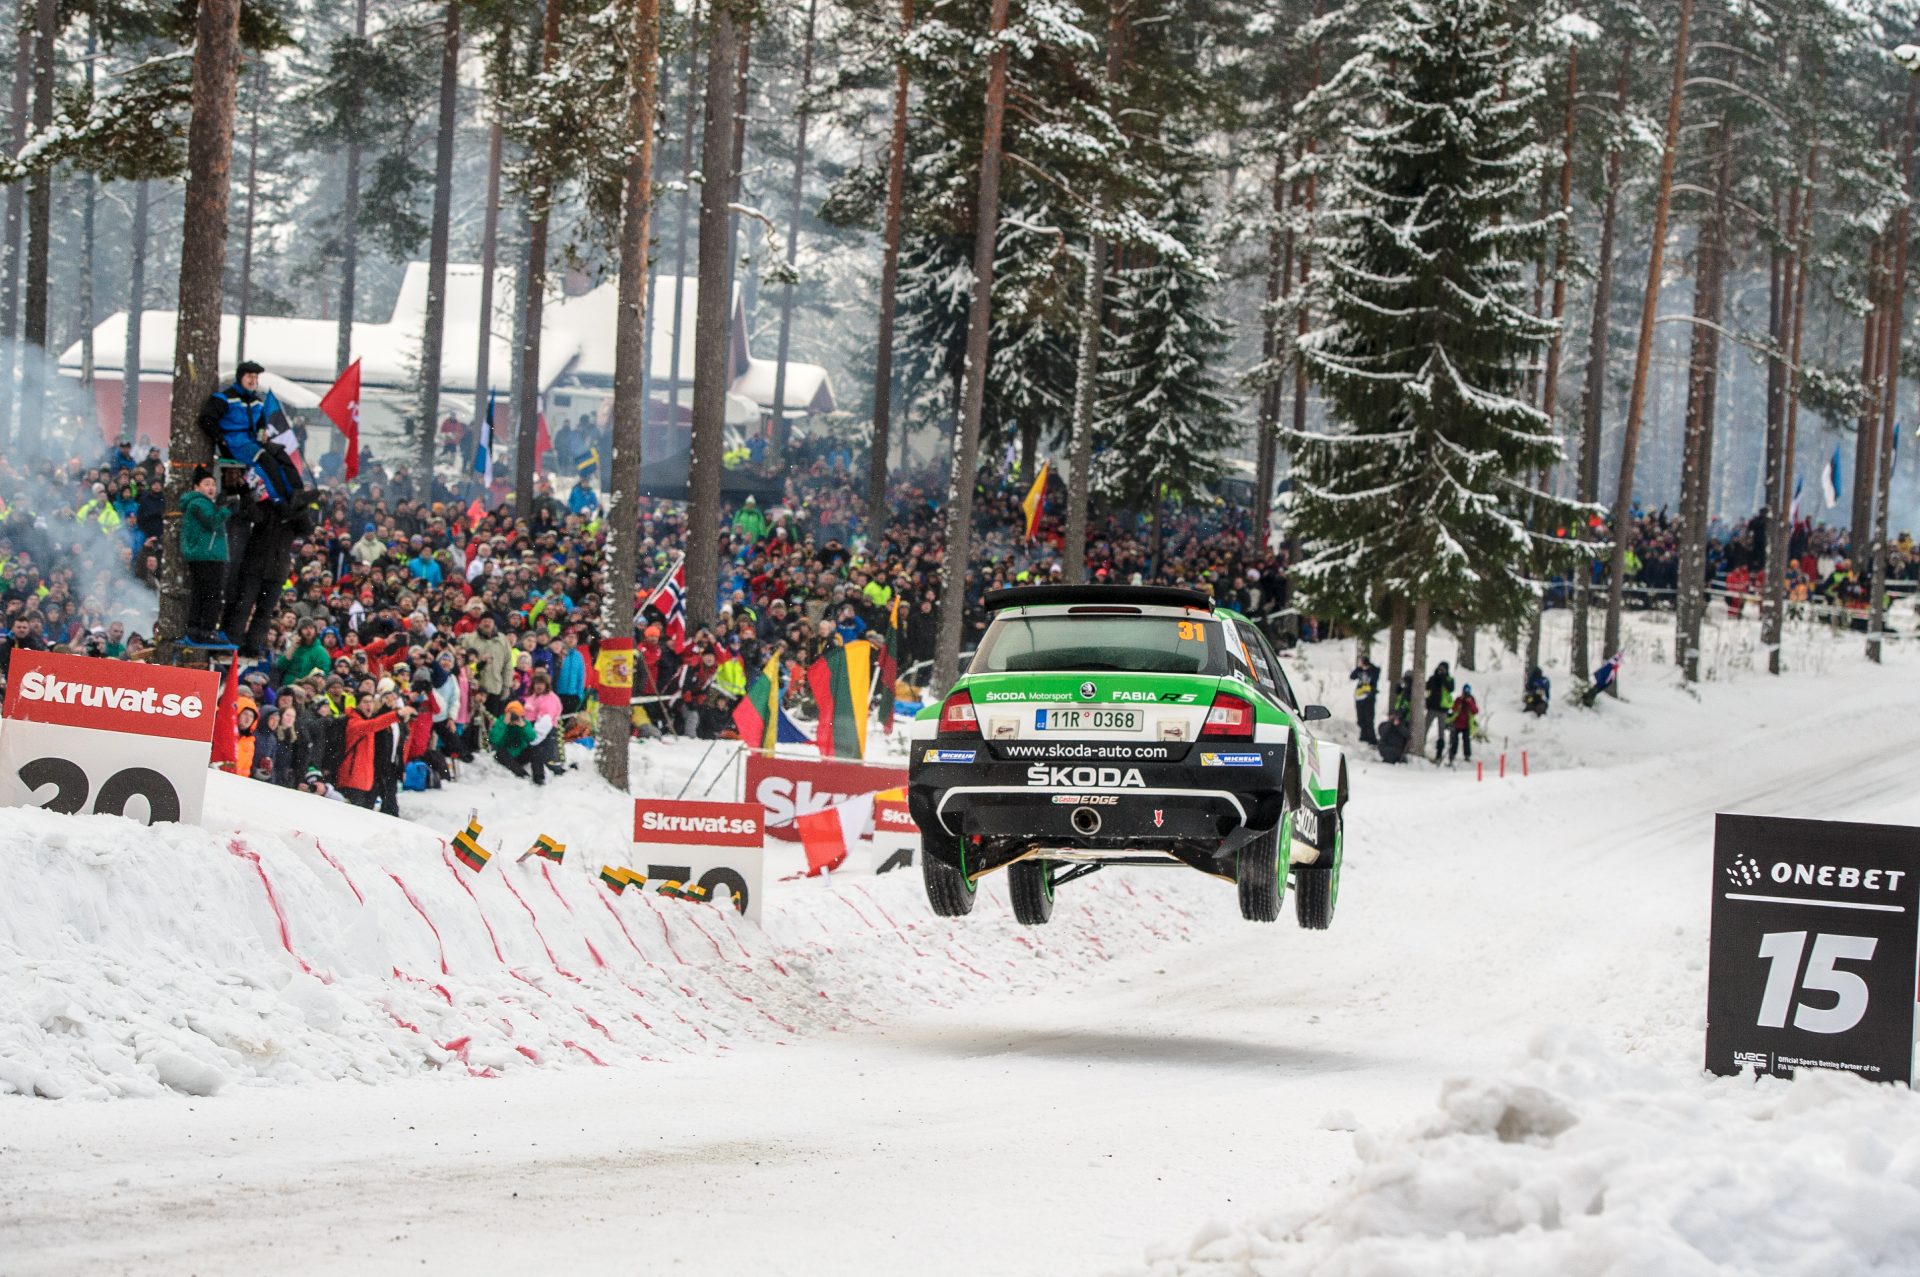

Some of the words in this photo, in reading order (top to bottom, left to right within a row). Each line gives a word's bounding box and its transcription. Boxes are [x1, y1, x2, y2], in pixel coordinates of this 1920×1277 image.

[1177, 620, 1205, 642] 31
[20, 671, 203, 719] Skruvat.se
[985, 691, 1026, 701] ŠKODA
[1028, 692, 1073, 702] Motorsport
[1112, 691, 1157, 701] FABIA
[1159, 692, 1198, 703] R5
[1051, 711, 1080, 728] 11R
[1093, 711, 1135, 728] 0368
[1223, 756, 1261, 764] MICHELIN
[1027, 762, 1146, 788] ŠKODA
[1080, 795, 1119, 805] EDGE
[642, 812, 757, 835] Skruvat.se
[1771, 862, 1906, 892] ONEBET
[1756, 930, 1878, 1034] 15
[1733, 1050, 1767, 1063] WRC
[1778, 1056, 1798, 1064] Official
[1799, 1058, 1818, 1066] Sports
[1840, 1062, 1862, 1071] Partner
[1870, 1065, 1881, 1073] the
